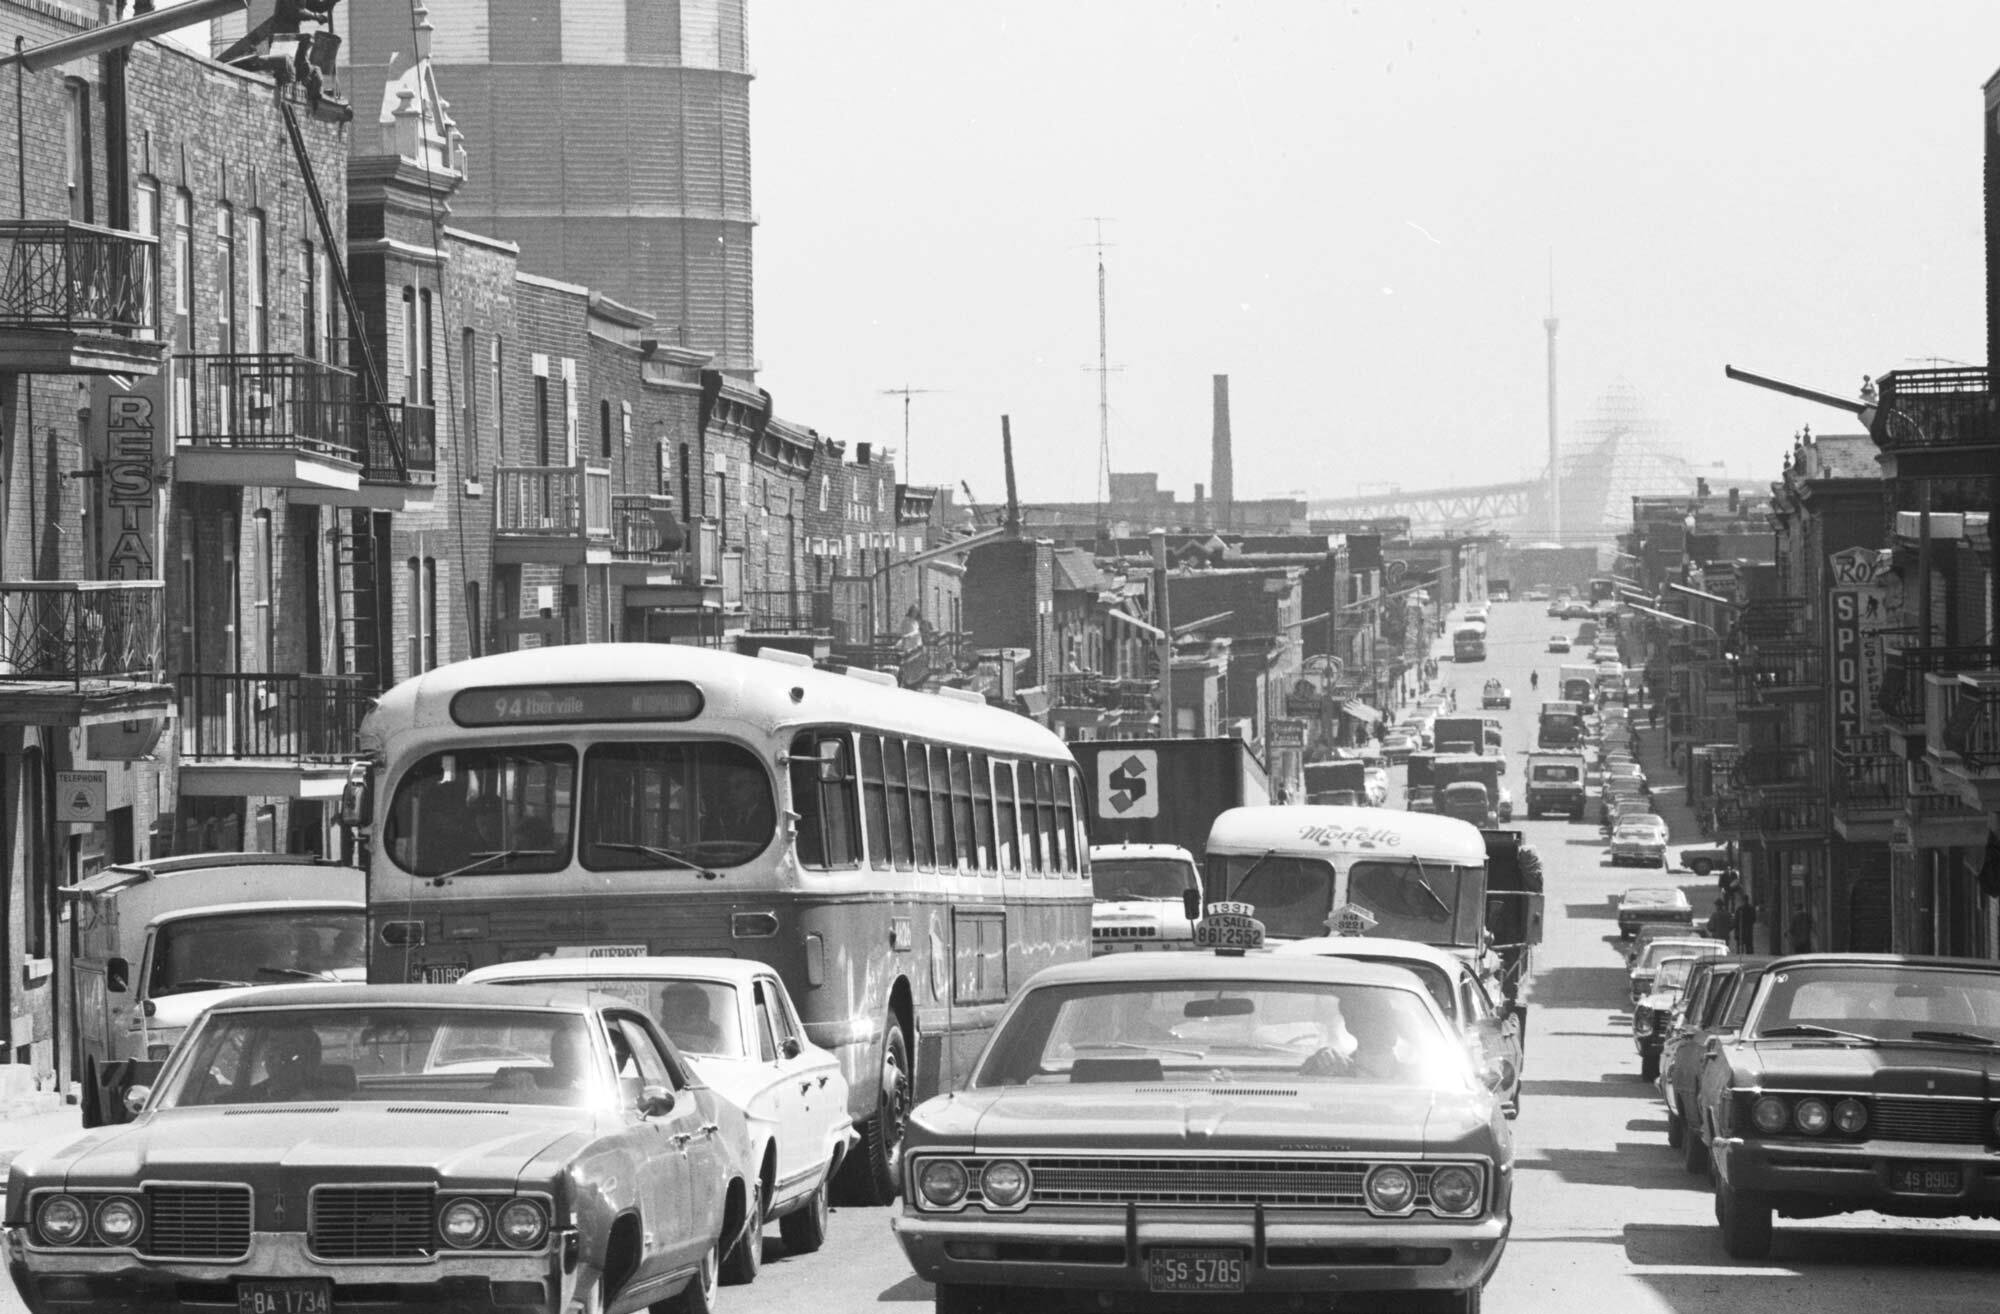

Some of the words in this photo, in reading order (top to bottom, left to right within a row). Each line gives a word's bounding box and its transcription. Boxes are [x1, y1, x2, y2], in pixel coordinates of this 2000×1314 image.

[495, 697, 521, 717] 94
[60, 774, 103, 783] TELEPHONE
[1299, 825, 1401, 847] Monette
[1213, 903, 1249, 915] 1331
[1208, 918, 1221, 928] LA
[1223, 916, 1254, 928] SALLE
